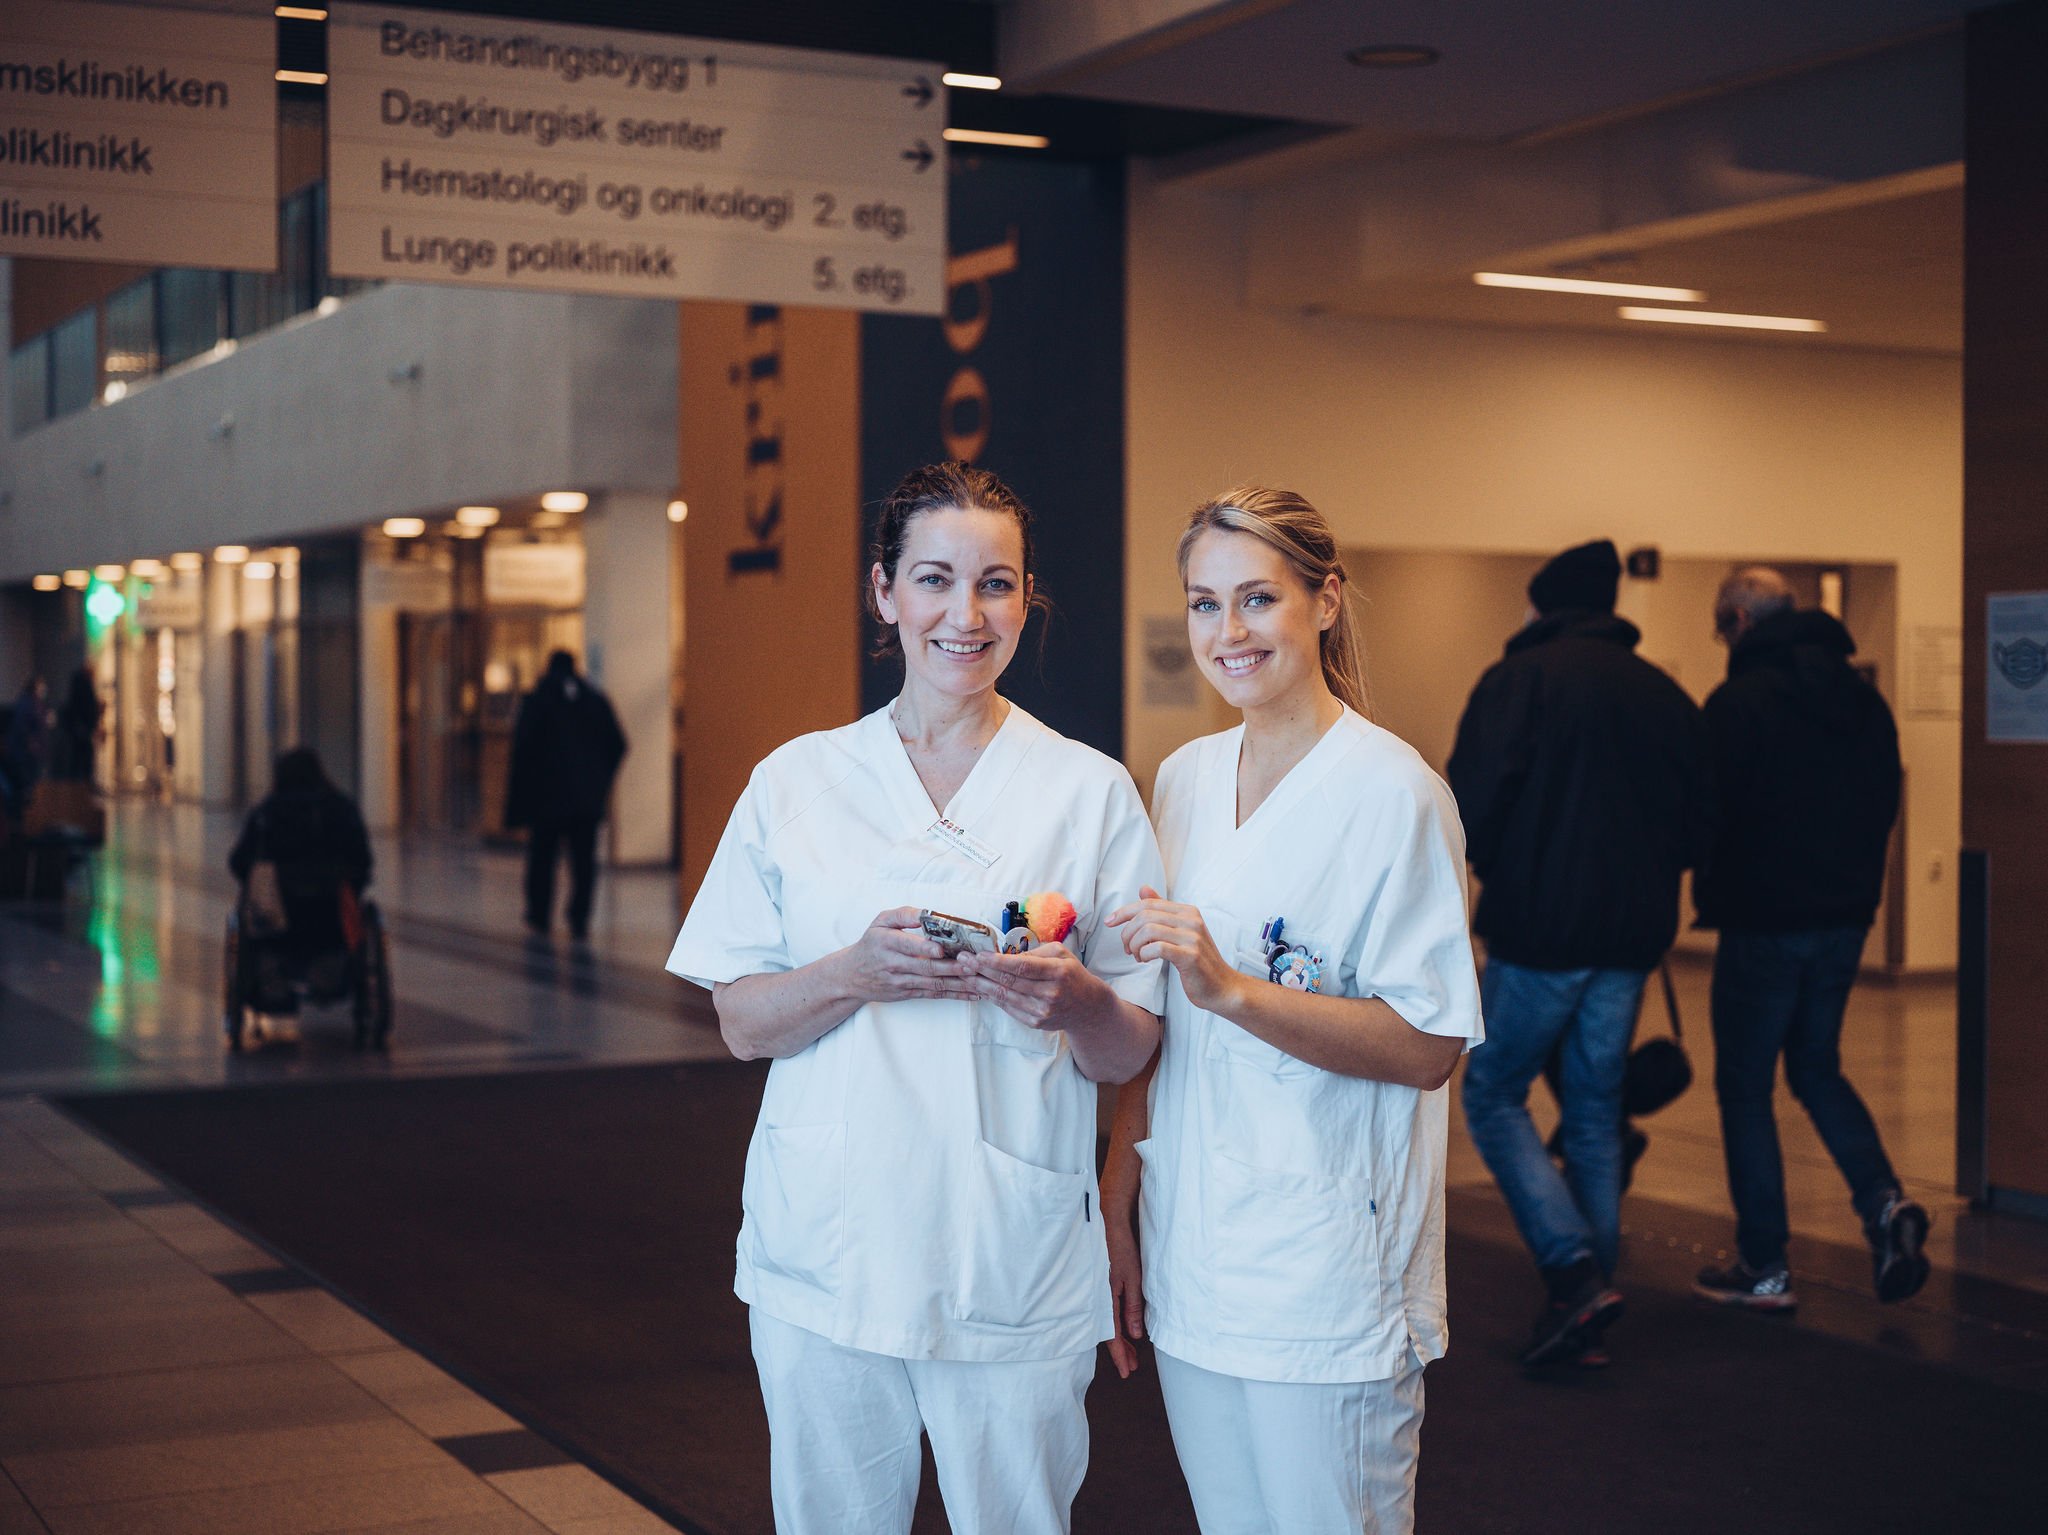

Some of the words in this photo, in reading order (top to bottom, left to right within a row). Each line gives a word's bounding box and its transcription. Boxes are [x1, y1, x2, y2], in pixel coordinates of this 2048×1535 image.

[380, 19, 692, 91] Behandlingsbygg
[703, 54, 718, 86] 1
[380, 89, 606, 145] Dagkirurgisk
[617, 119, 725, 153] senter
[380, 157, 589, 214] Hematologi
[597, 184, 641, 219] og
[650, 184, 795, 232] onkologi
[813, 194, 846, 228] 2.
[854, 202, 913, 240] etg.
[381, 227, 497, 275] Lunge
[505, 235, 677, 281] poliklinikk
[814, 257, 846, 292] 5.
[853, 265, 913, 303] etg.
